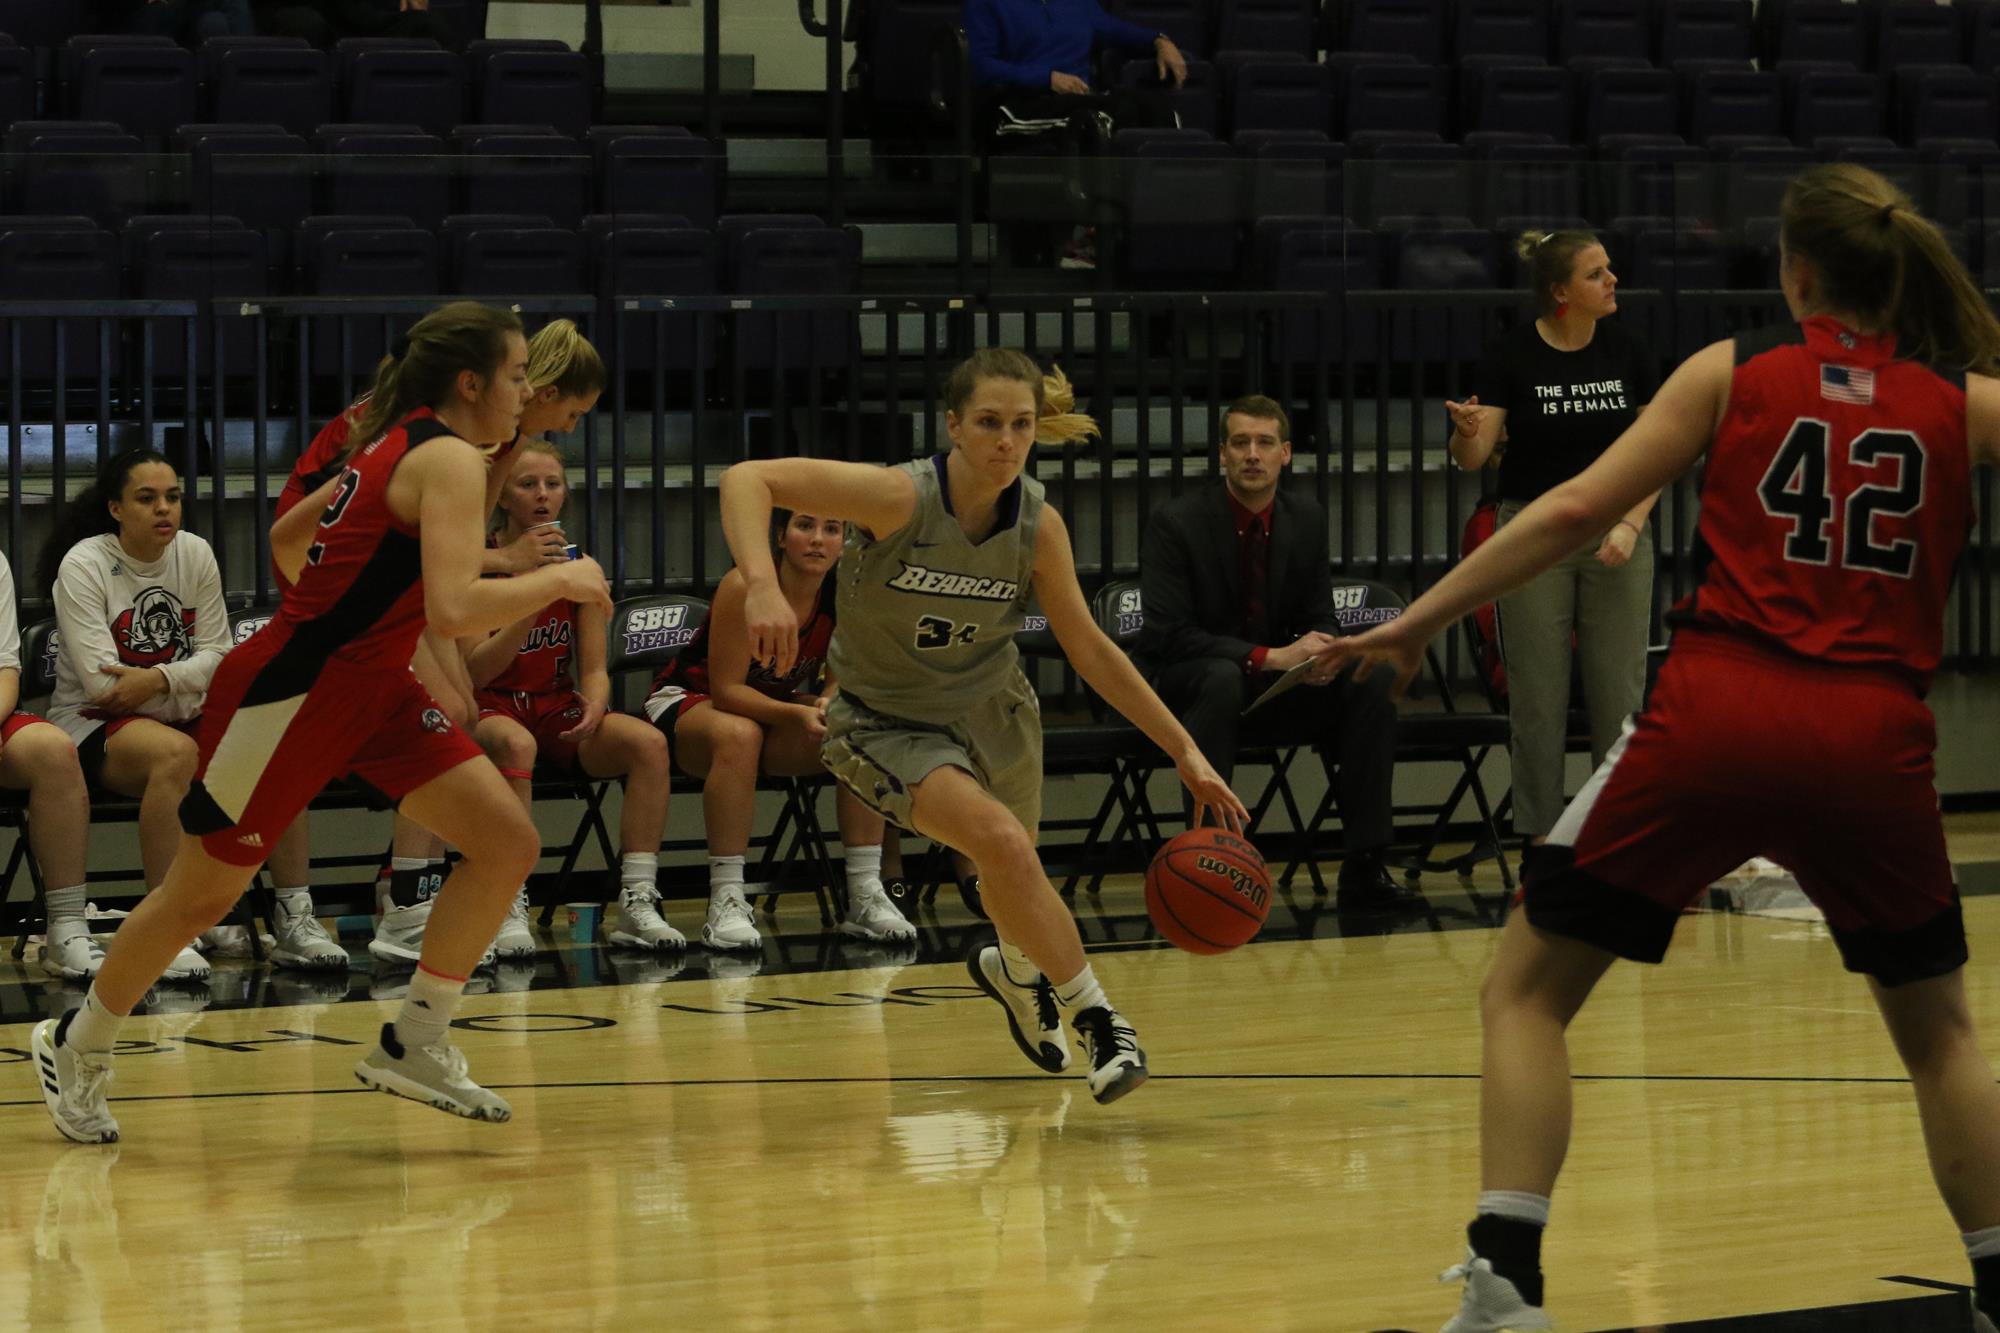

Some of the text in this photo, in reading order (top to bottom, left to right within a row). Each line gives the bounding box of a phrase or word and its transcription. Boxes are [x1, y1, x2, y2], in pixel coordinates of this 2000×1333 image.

[1534, 379, 1624, 398] THE FUTURE
[1543, 395, 1627, 415] IS FEMALE
[1756, 416, 1928, 579] 42
[885, 560, 1018, 602] BEARCAT
[1332, 585, 1368, 609] BU
[627, 604, 688, 634] SBU
[1335, 608, 1401, 627] ARCATS
[623, 628, 700, 655] BEARC
[1197, 855, 1267, 911] Wilson
[662, 986, 992, 1015] ohn
